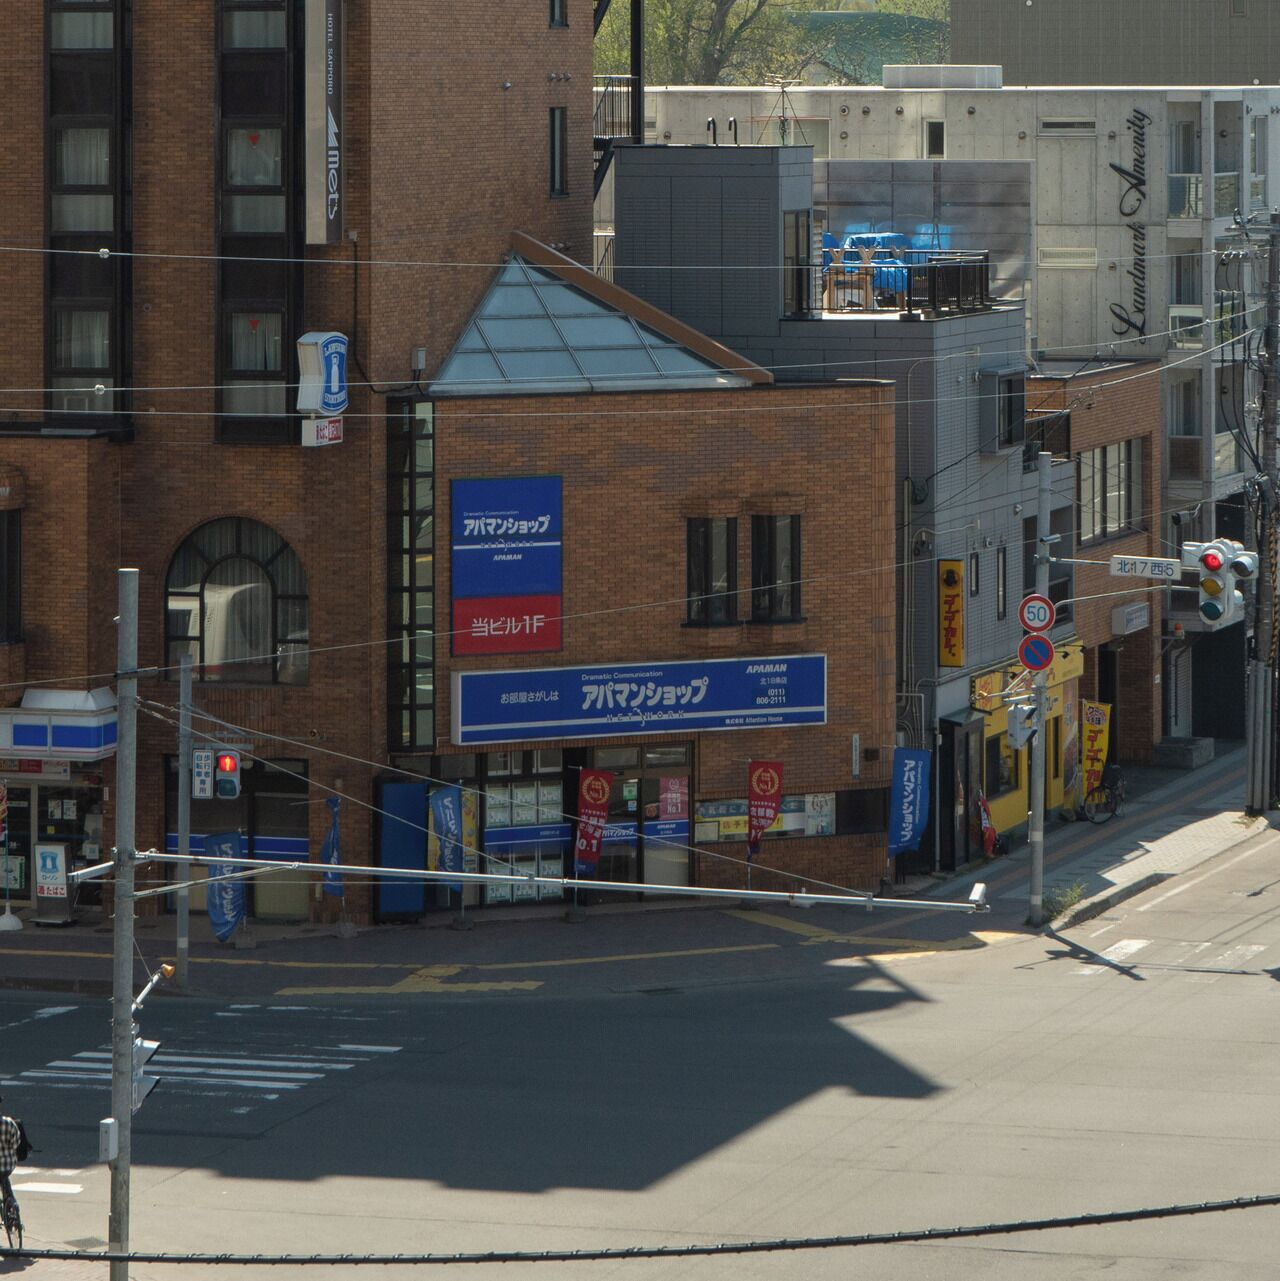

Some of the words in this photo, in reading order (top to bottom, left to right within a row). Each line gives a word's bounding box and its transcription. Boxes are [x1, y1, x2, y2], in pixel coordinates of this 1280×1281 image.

[1109, 108, 1152, 217] Amenity
[327, 150, 340, 220] mets
[1109, 223, 1147, 345] Landmark
[463, 515, 551, 536] アパマンショップ
[1026, 605, 1047, 622] 50
[472, 615, 545, 637] 当ビル1F
[581, 672, 612, 681] Dramatic
[613, 670, 663, 679] Communication
[746, 663, 787, 674] APAMAN
[500, 690, 559, 704] お部屋さがしは
[582, 676, 709, 710] アパマンショップ
[756, 696, 786, 705] 806-2111
[768, 688, 785, 696] (011)
[667, 803, 681, 814] No.1
[901, 760, 916, 841] アパマンショップ
[46, 886, 65, 896] たばこ
